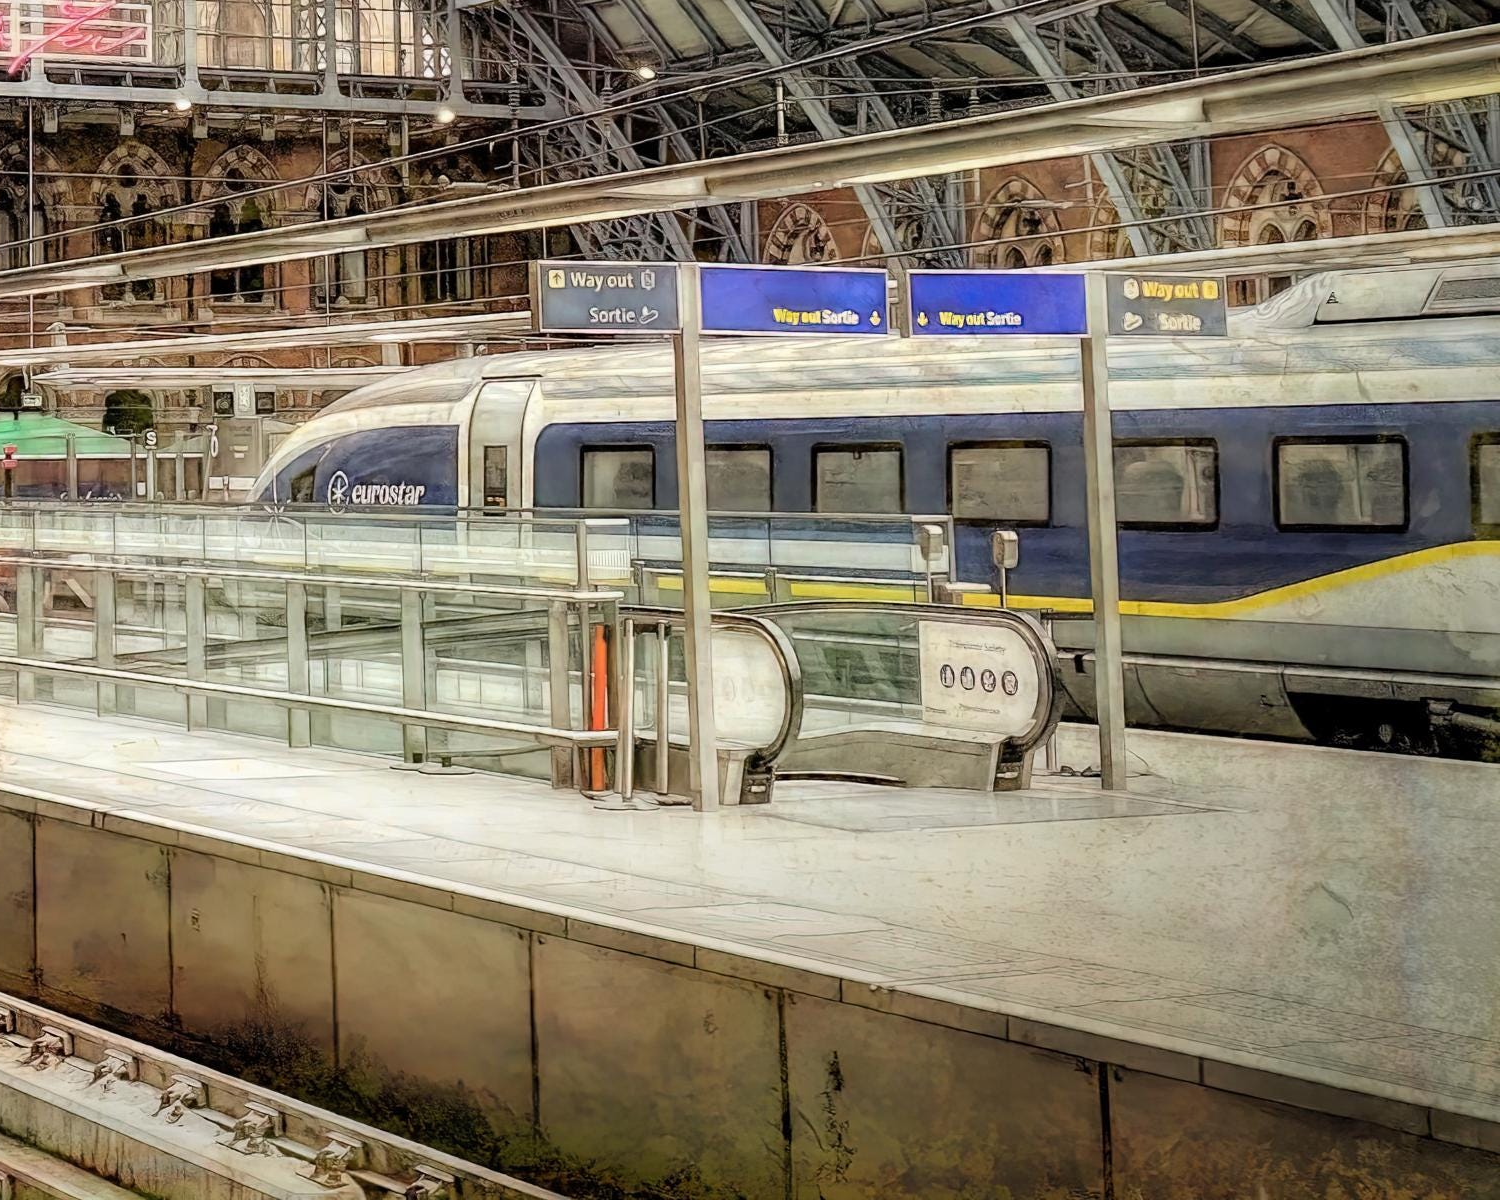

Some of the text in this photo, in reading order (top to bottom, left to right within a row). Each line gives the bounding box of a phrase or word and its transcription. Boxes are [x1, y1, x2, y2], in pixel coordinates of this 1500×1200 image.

[570, 272, 634, 291] Way out
[1141, 280, 1199, 302] Way out
[589, 307, 636, 323] Sortie
[772, 308, 799, 325] Way
[821, 309, 860, 325] Sortie
[938, 311, 1022, 328] Way out Sortie
[1158, 312, 1202, 331] Sortie
[145, 431, 157, 446] S
[351, 482, 426, 506] eurostar
